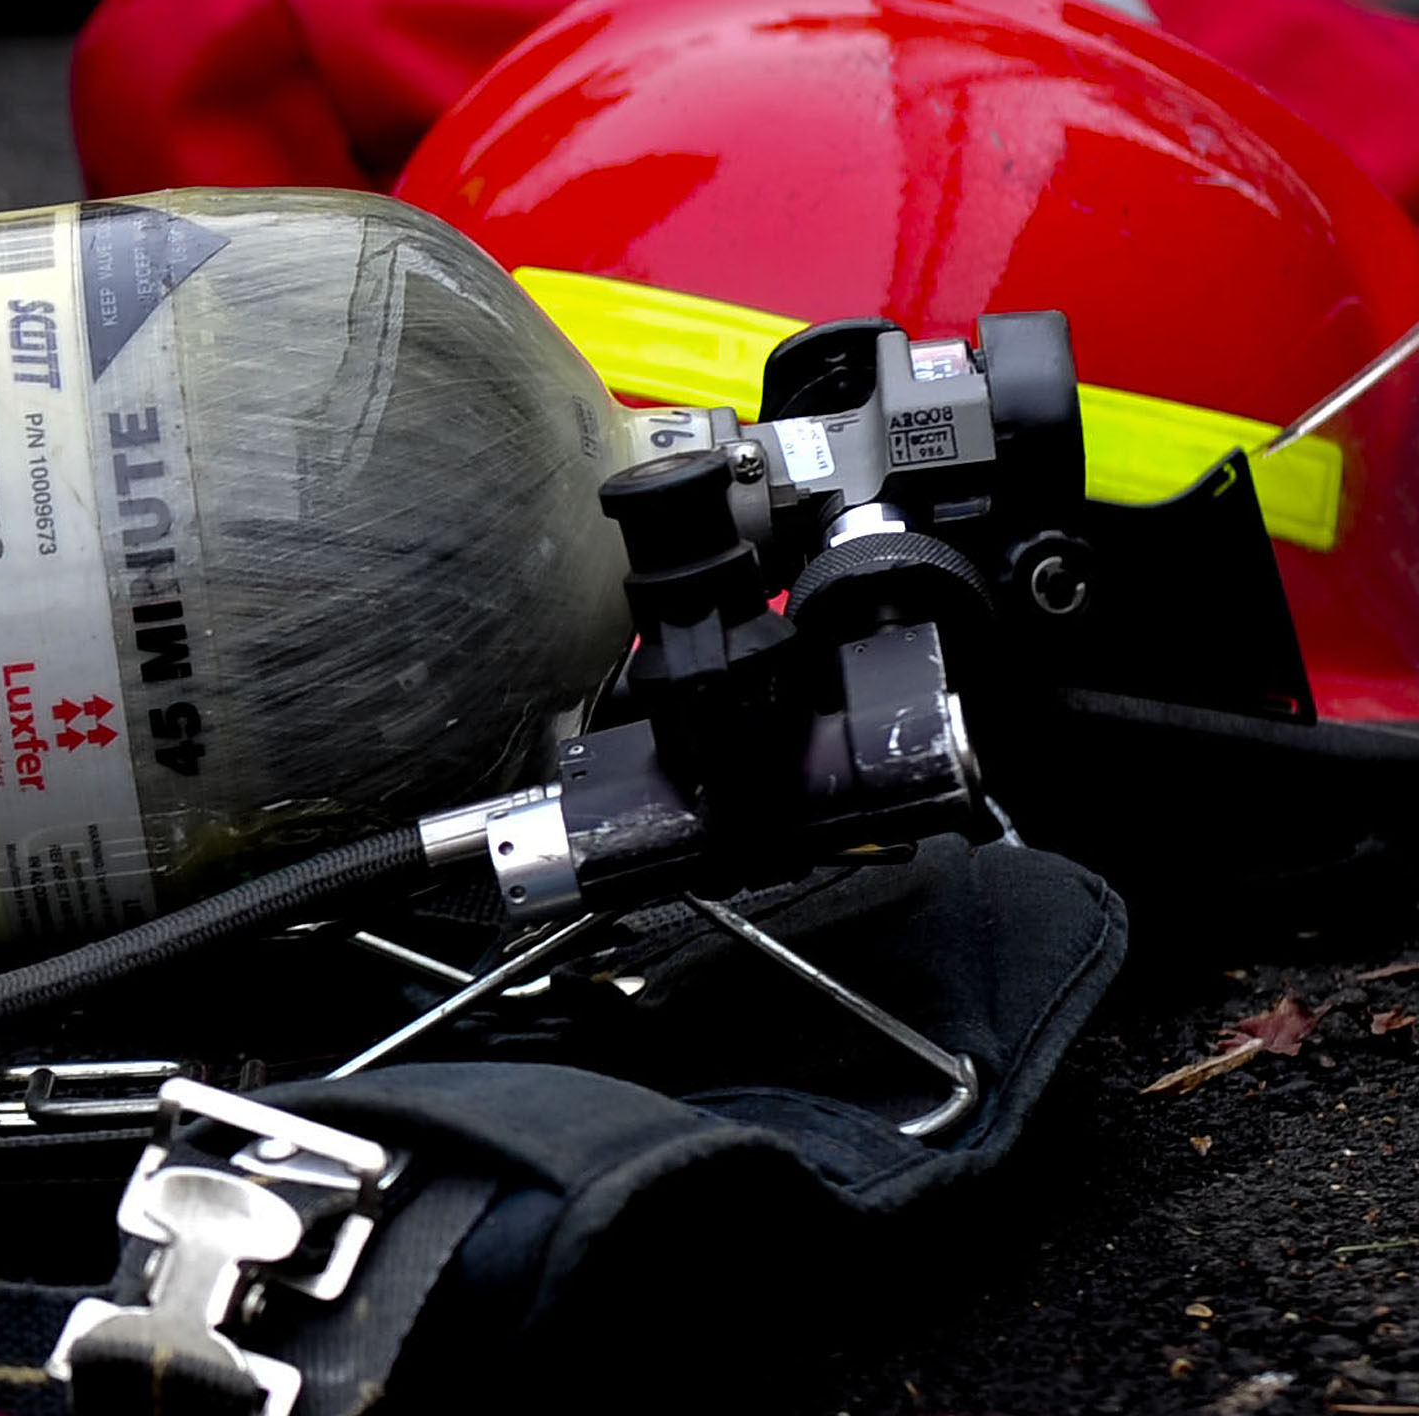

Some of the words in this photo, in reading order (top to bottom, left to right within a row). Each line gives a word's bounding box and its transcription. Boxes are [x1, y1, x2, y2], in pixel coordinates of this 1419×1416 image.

[8, 297, 62, 391] SCOTT
[99, 288, 118, 326] KEEP
[24, 413, 45, 448] P/N
[29, 454, 57, 556] 10009673
[4, 662, 48, 793] Luxfer
[150, 701, 205, 777] 45
